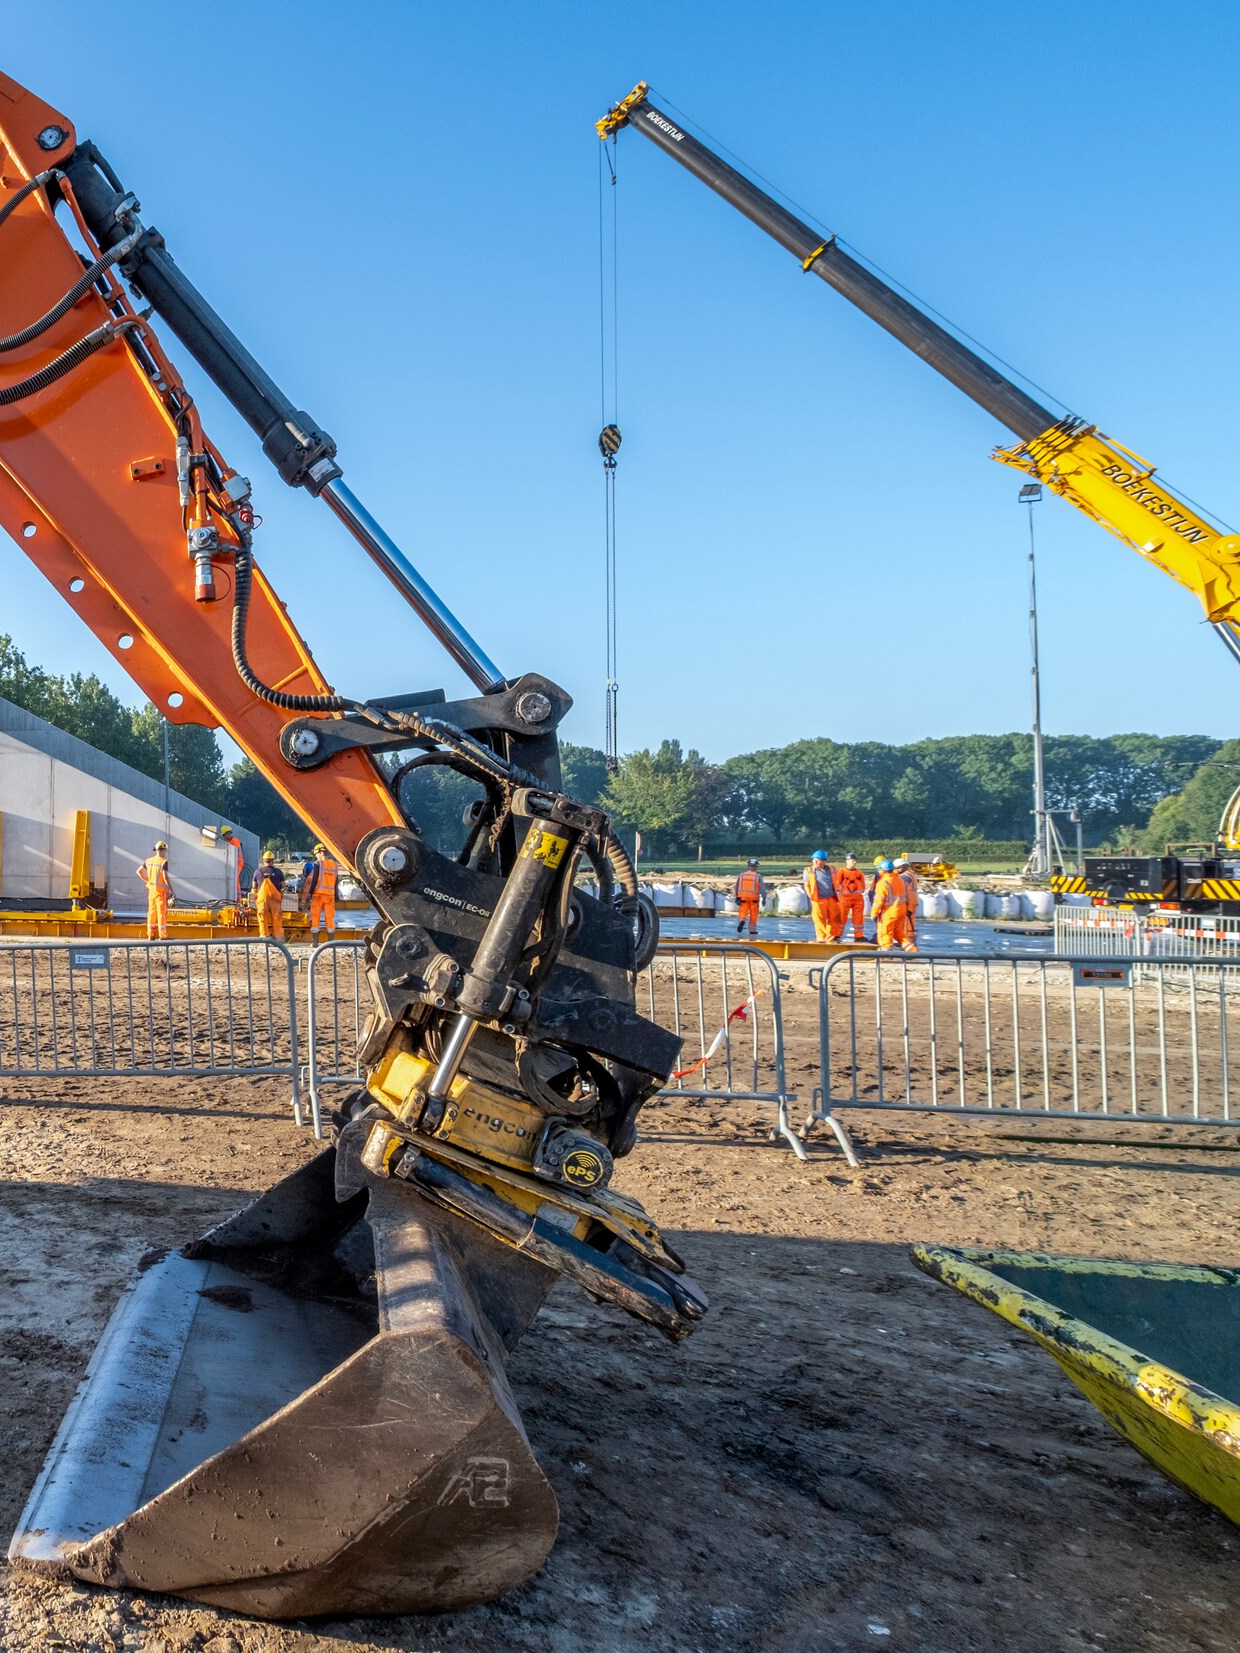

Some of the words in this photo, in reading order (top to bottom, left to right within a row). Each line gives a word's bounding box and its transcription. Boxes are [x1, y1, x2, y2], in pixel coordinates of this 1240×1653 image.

[1101, 464, 1209, 545] BOEKESTIJN
[423, 887, 463, 907] engcon
[463, 1107, 538, 1142] engcon
